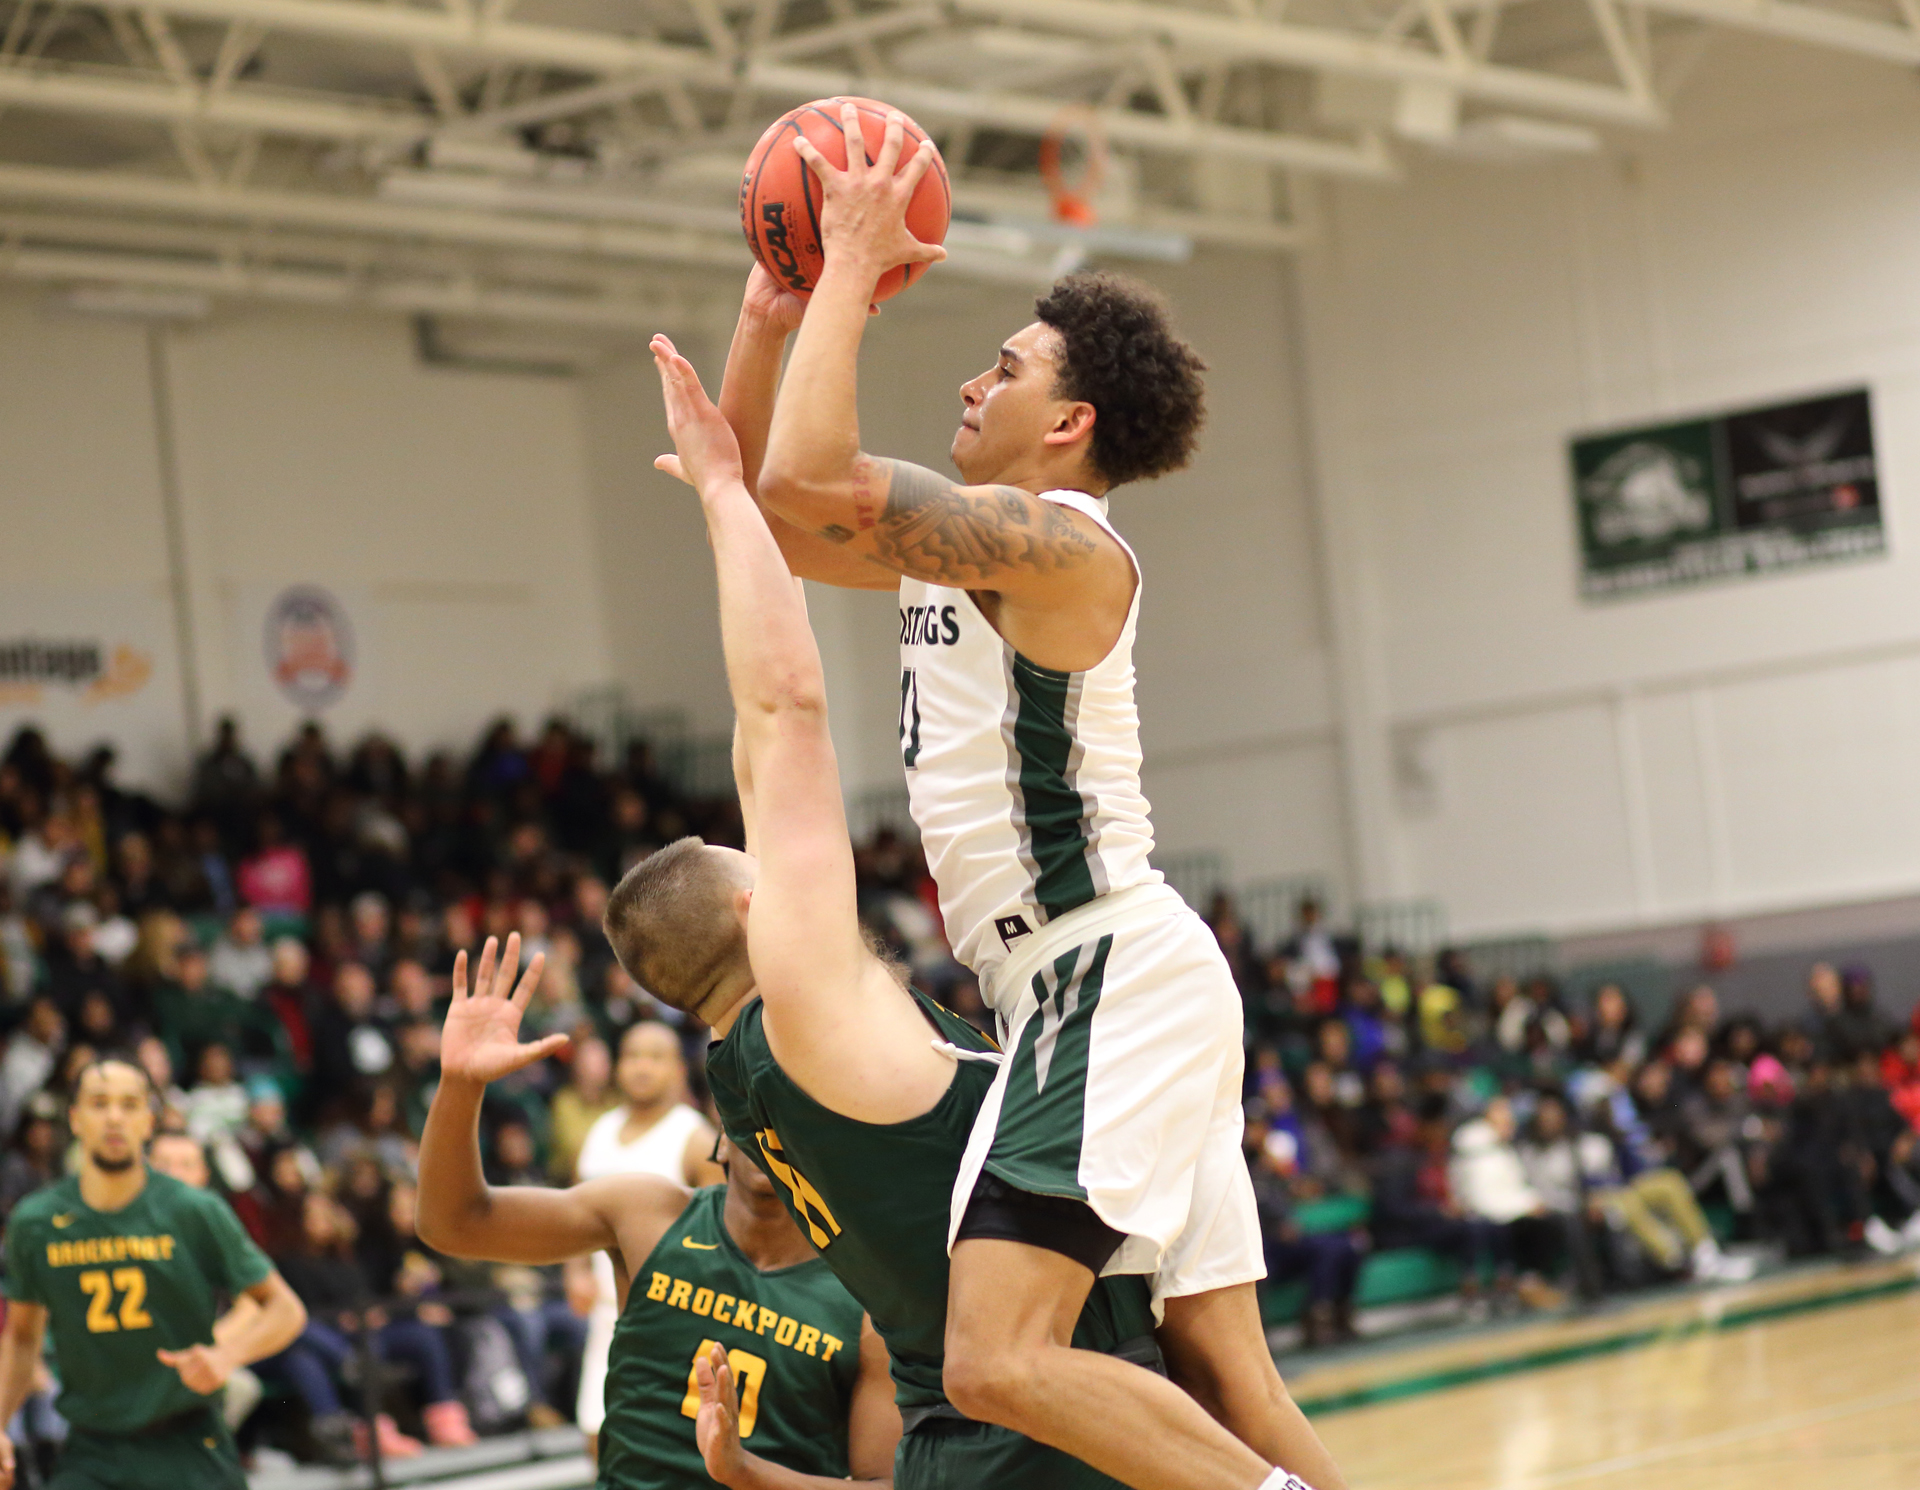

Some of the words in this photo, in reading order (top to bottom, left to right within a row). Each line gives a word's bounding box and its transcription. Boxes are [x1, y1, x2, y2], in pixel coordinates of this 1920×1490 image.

[762, 202, 815, 292] NCAA
[79, 1266, 154, 1334] 22
[646, 1271, 844, 1362] BROCKPORT
